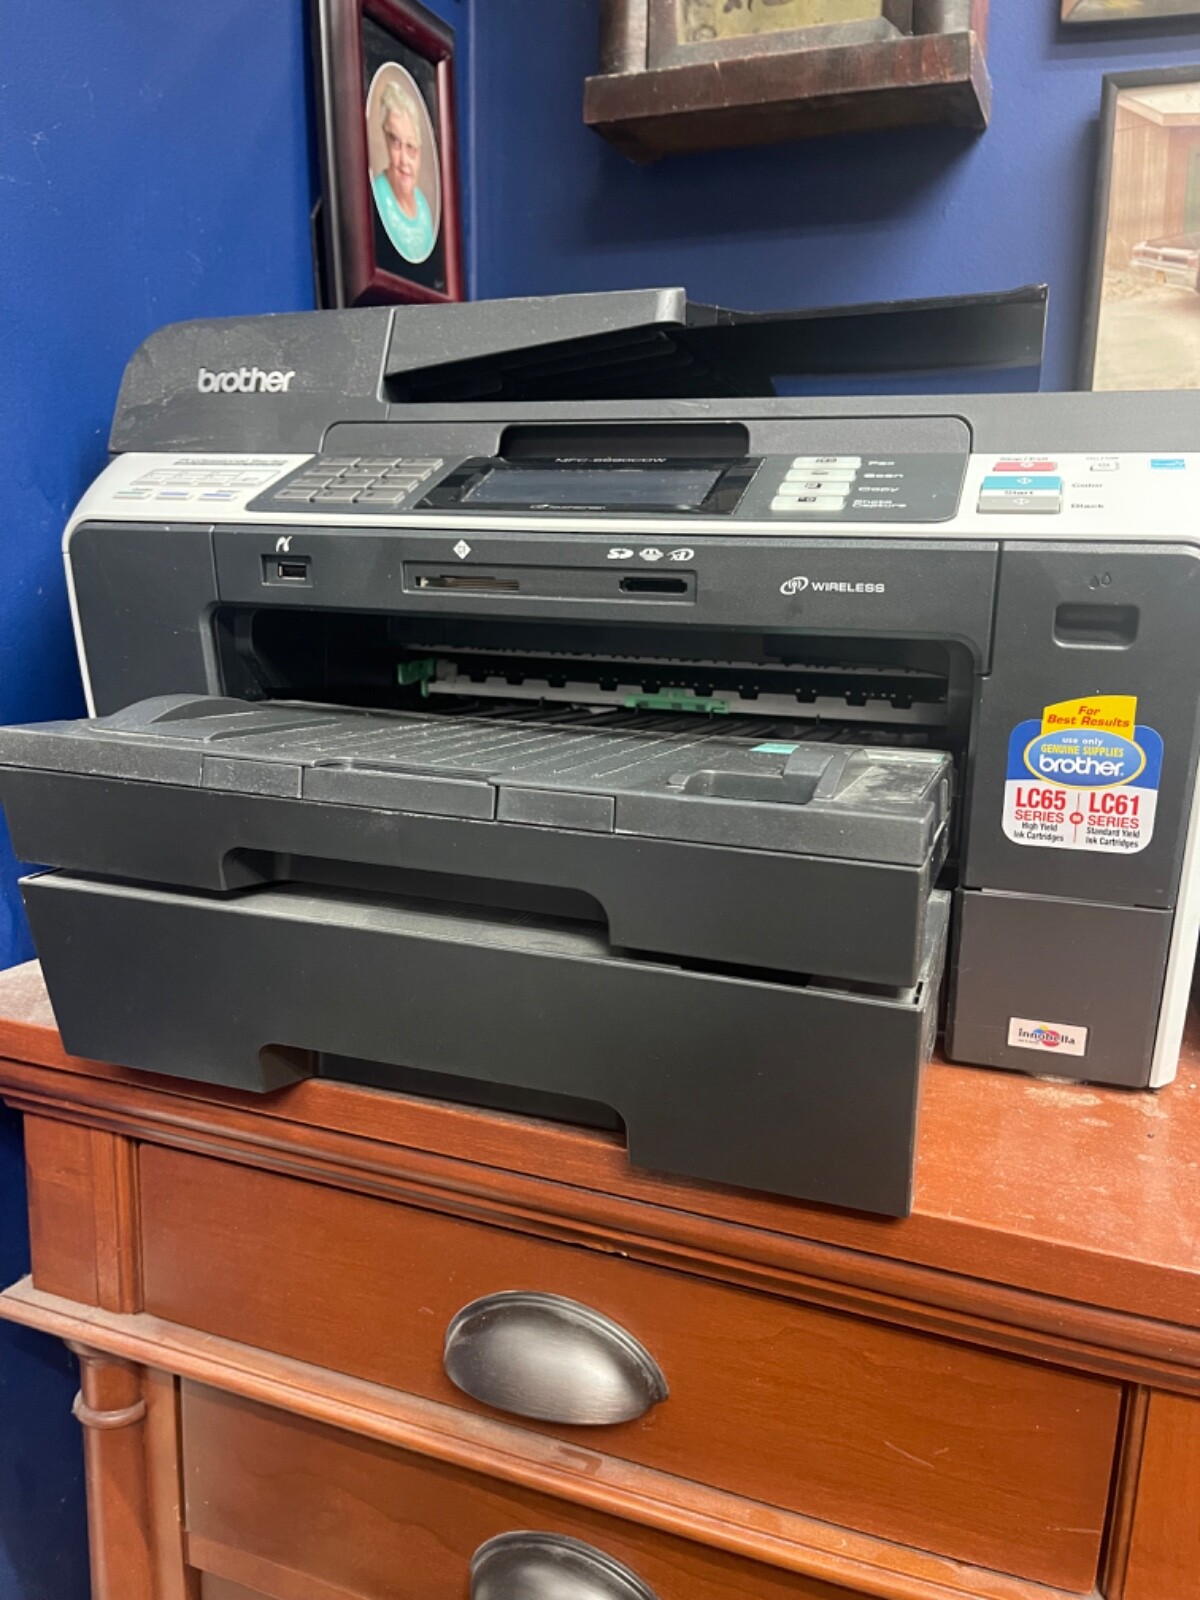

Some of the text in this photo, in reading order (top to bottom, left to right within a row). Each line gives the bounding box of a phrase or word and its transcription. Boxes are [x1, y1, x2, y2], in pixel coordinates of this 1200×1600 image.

[198, 367, 296, 393] brother
[811, 582, 885, 593] WIRELESS
[1078, 705, 1101, 716] For
[1046, 714, 1130, 728] Best Results
[1082, 737, 1104, 746] only
[1040, 743, 1125, 758] GENUINE SUPPLIES
[1015, 787, 1067, 811] LC65
[1088, 792, 1140, 816] LC61
[1014, 809, 1065, 824] SERIES
[1087, 815, 1140, 829] SERIES
[1021, 822, 1058, 832] High Yield
[1086, 827, 1141, 839] Standard Yield
[1013, 830, 1065, 843] Ink Cartridges
[1099, 837, 1139, 849] Cartridges
